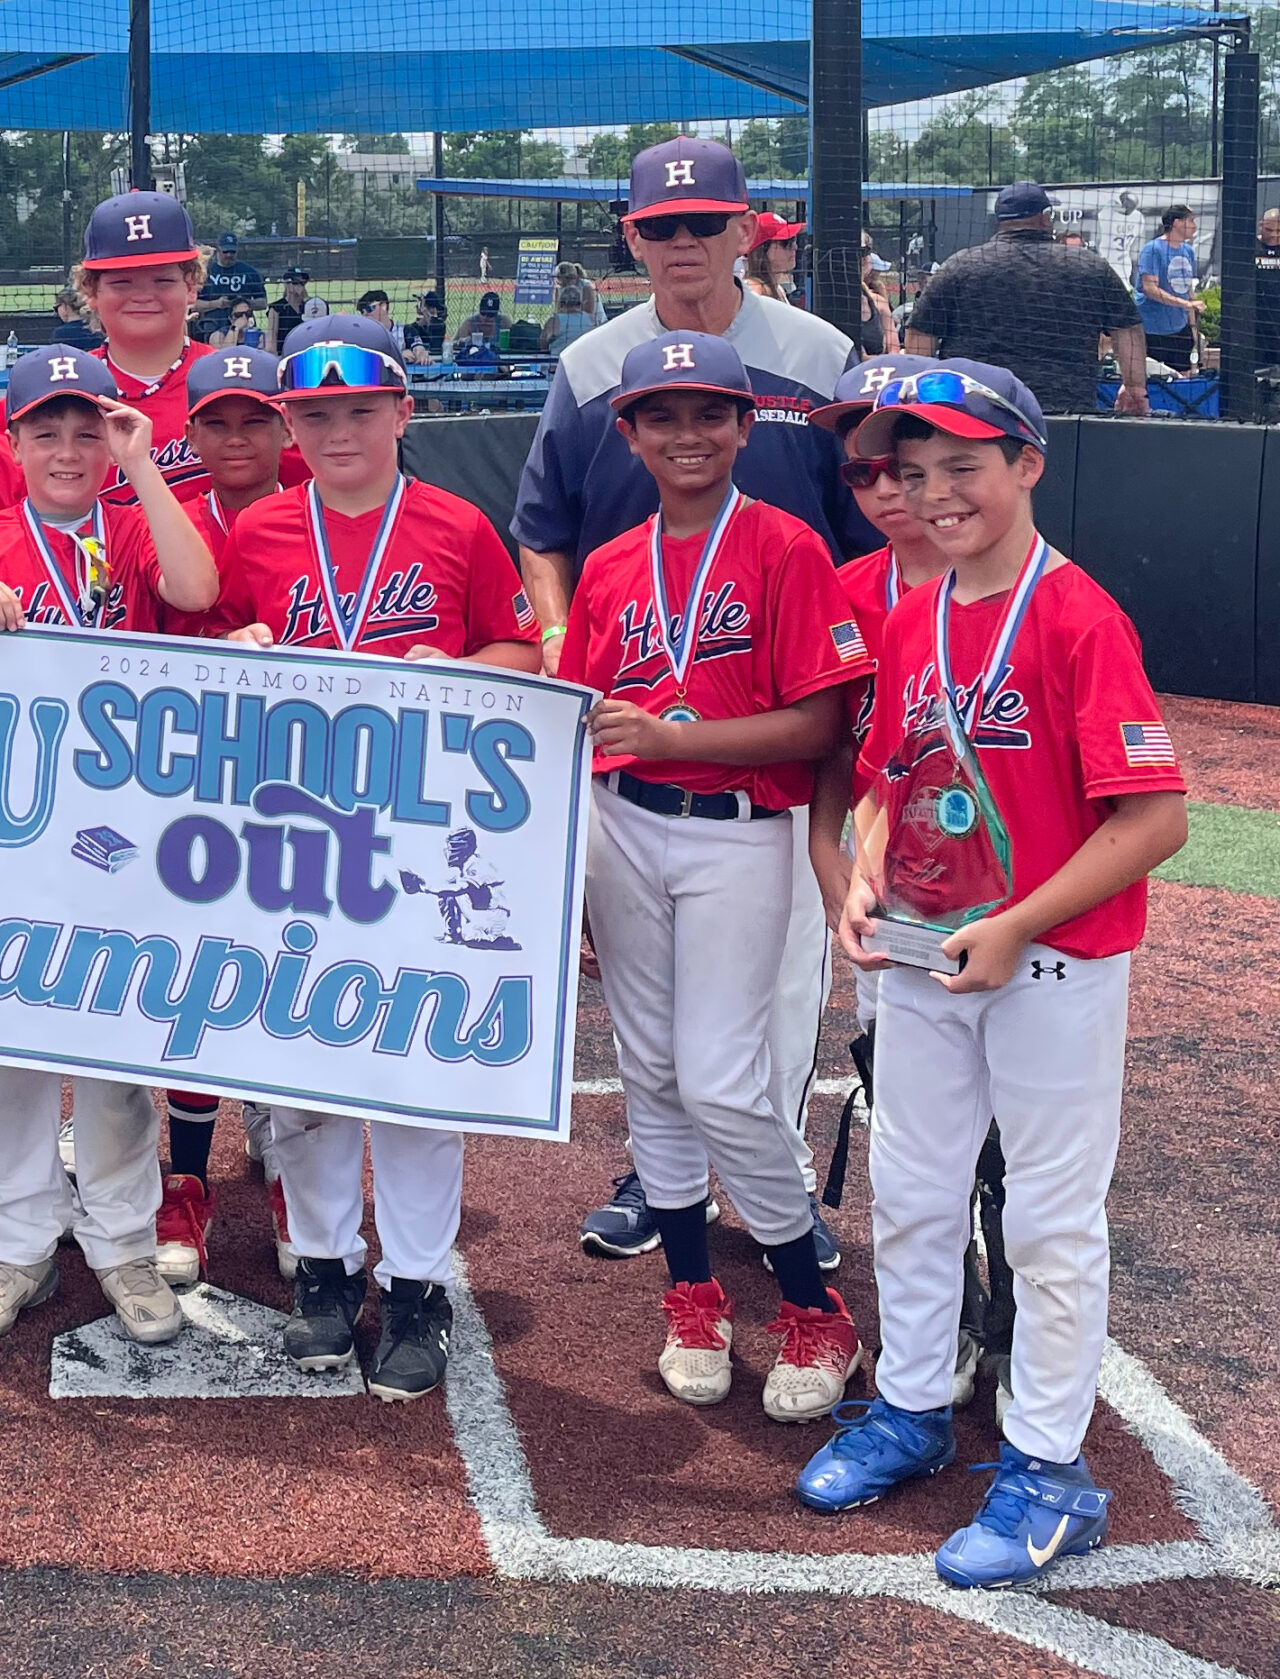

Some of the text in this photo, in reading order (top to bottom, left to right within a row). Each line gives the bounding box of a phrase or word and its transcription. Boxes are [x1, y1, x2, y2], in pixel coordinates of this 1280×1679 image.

[665, 160, 696, 188] H
[125, 214, 154, 242] H
[1060, 209, 1083, 225] UP
[48, 356, 80, 383] H
[223, 356, 253, 379] H
[662, 343, 696, 371] H
[859, 366, 897, 395] H
[753, 408, 809, 426] ASEBALL
[754, 395, 811, 411] USTLE
[99, 654, 524, 712] 2024 DIAMOND NATION
[73, 680, 536, 833] SCHOOL'S
[155, 778, 399, 925] out
